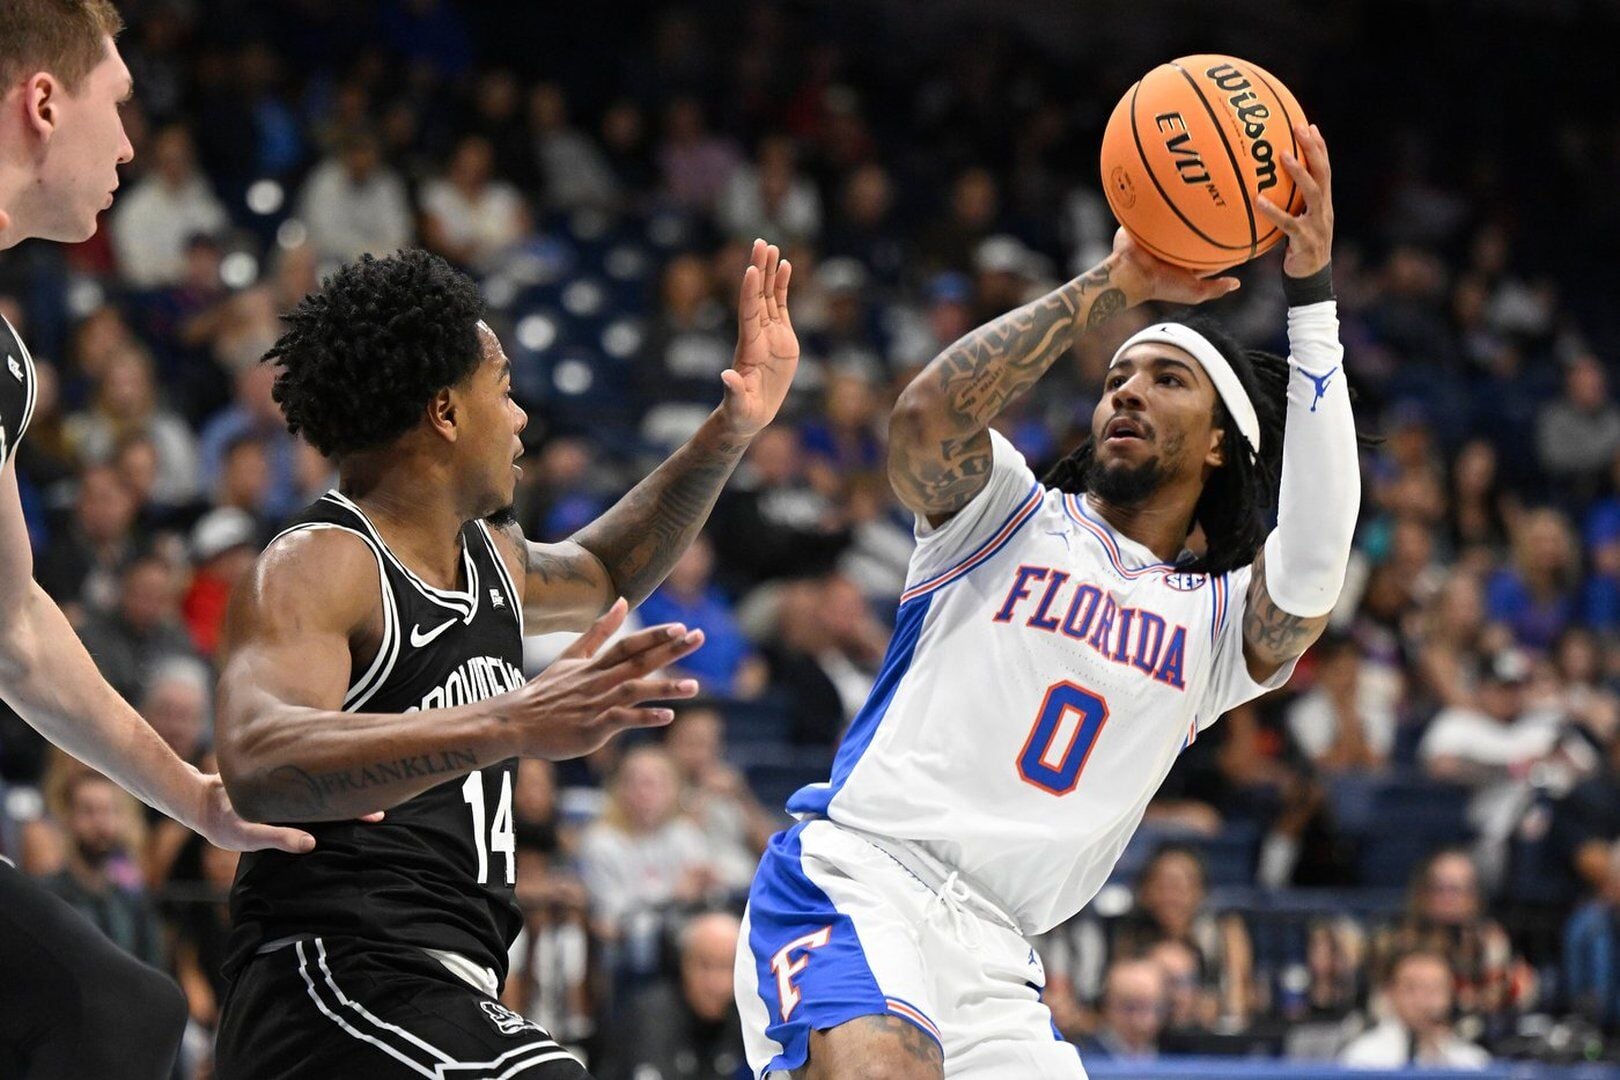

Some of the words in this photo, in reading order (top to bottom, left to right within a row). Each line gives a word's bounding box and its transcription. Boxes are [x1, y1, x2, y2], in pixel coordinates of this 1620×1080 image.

[1155, 111, 1210, 185] EVO
[1206, 184, 1226, 207] NXT
[1206, 63, 1277, 193] Wilson
[993, 565, 1187, 691] FLORIDA
[1167, 572, 1205, 590] SEC
[318, 749, 479, 796] FRANKLIN
[1015, 679, 1110, 797] 0
[462, 770, 515, 884] 14
[769, 924, 832, 1023] F
